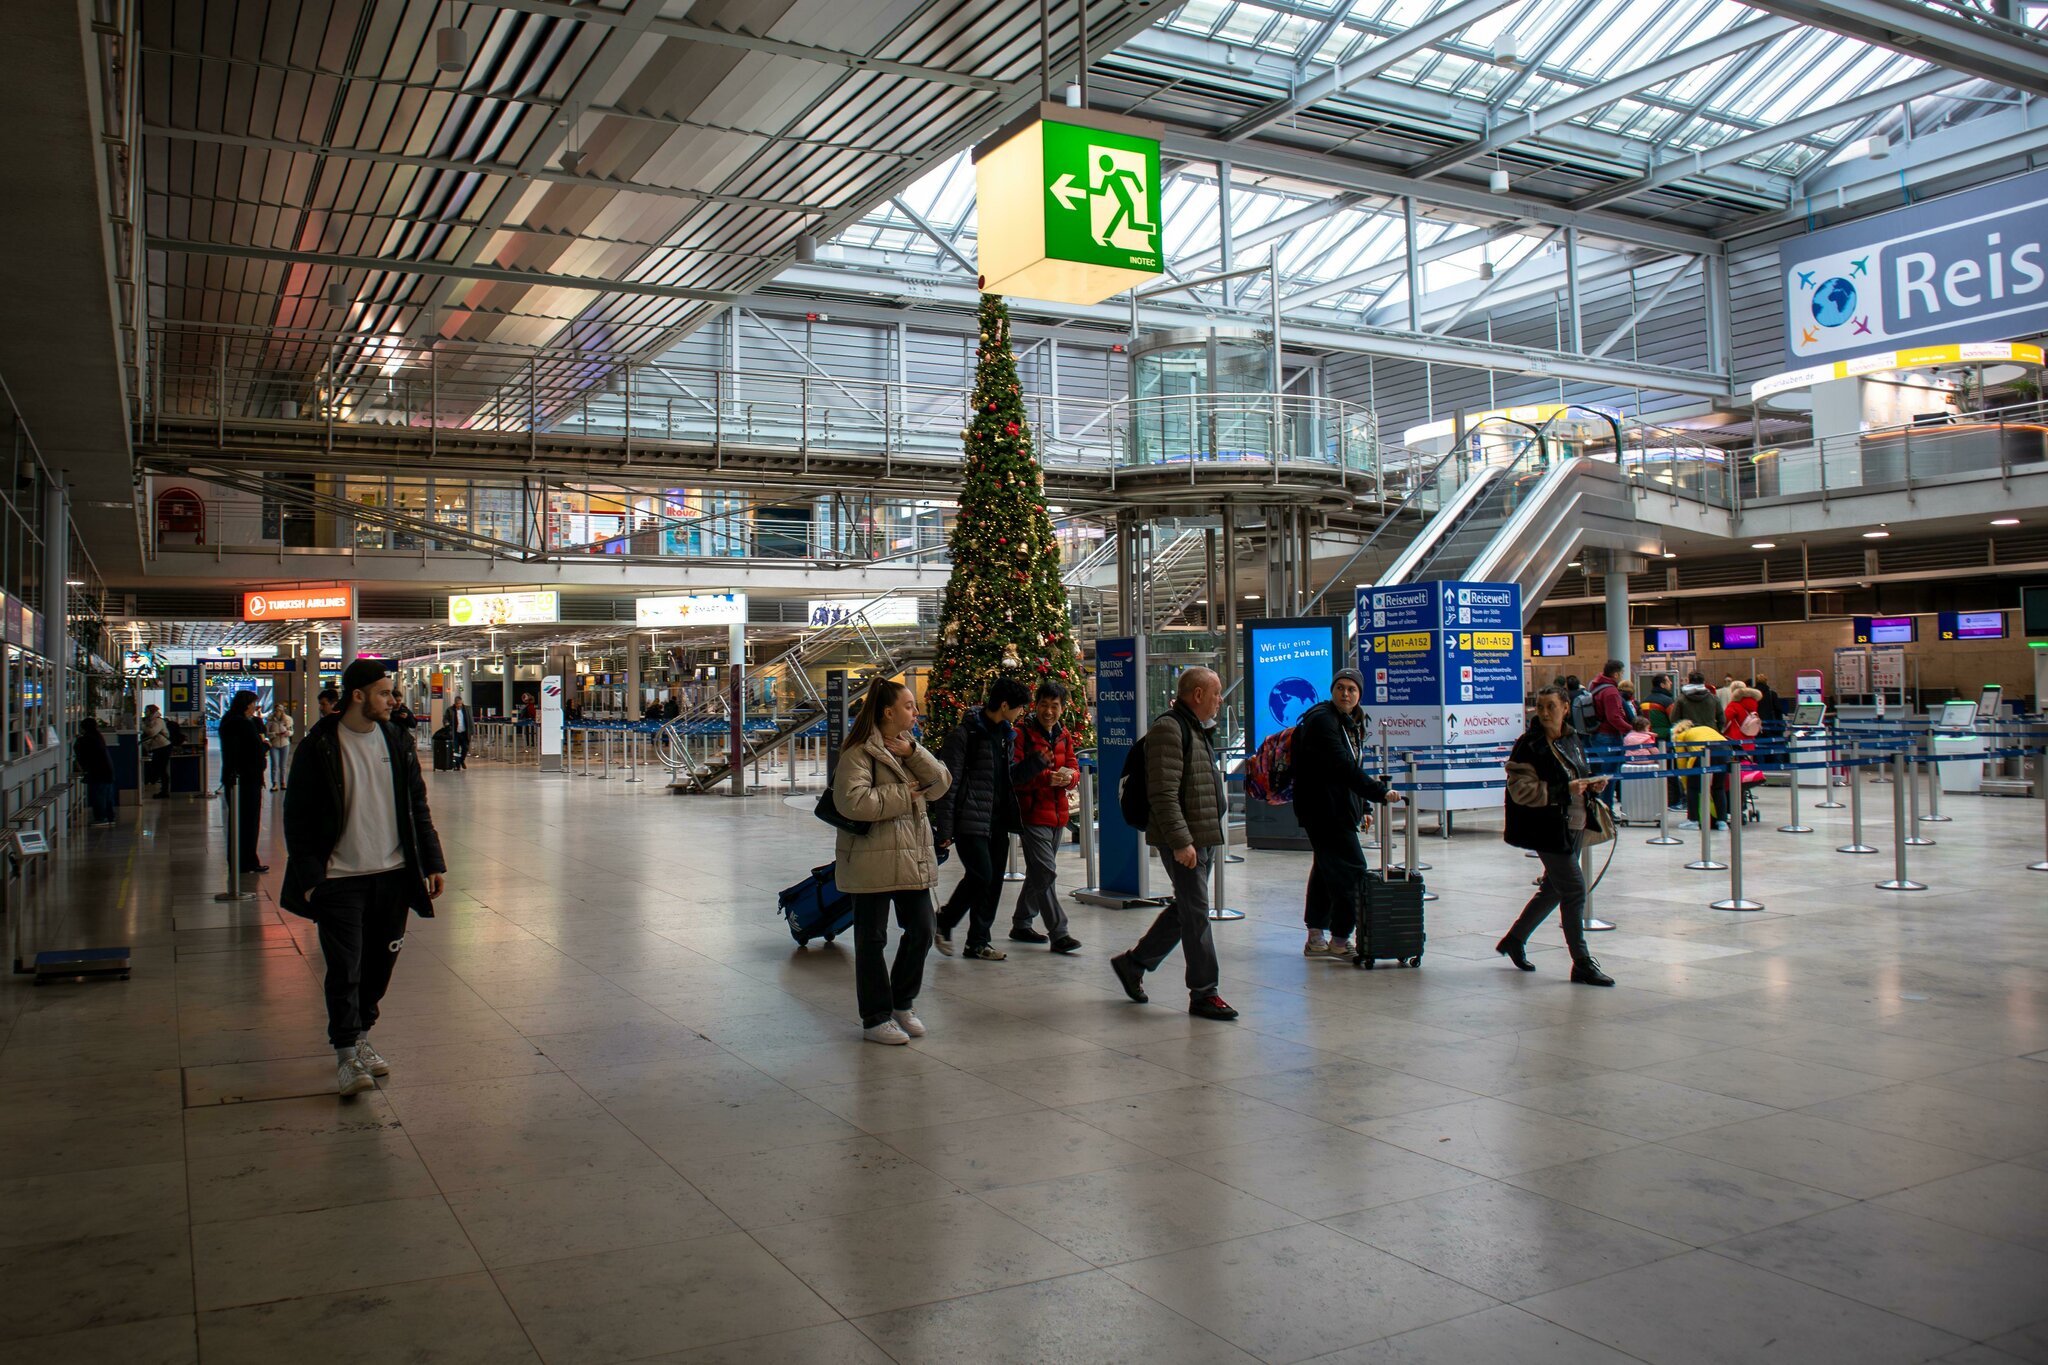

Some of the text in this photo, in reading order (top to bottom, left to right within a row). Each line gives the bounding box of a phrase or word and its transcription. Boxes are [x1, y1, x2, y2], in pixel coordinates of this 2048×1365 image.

[1130, 256, 1156, 266] INOTEC
[1896, 232, 2044, 320] Reis
[1386, 592, 1426, 606] Reisewelt
[1471, 592, 1508, 604] Reisewelt
[268, 598, 346, 610] TURKISH AIRLINES
[1391, 638, 1428, 648] A01-A152
[1476, 637, 1510, 646] A01-A152
[1261, 643, 1275, 652] Wir
[1260, 649, 1328, 663] bessere Zukunft
[1100, 661, 1122, 669] BRITISH
[1100, 669, 1123, 677] AIRWAYS
[1100, 691, 1134, 701] CHECK-IN
[1379, 716, 1426, 728] MÖVENPICK
[1464, 716, 1510, 727] MÖVENPICK
[1103, 738, 1133, 746] TRAVELLER
